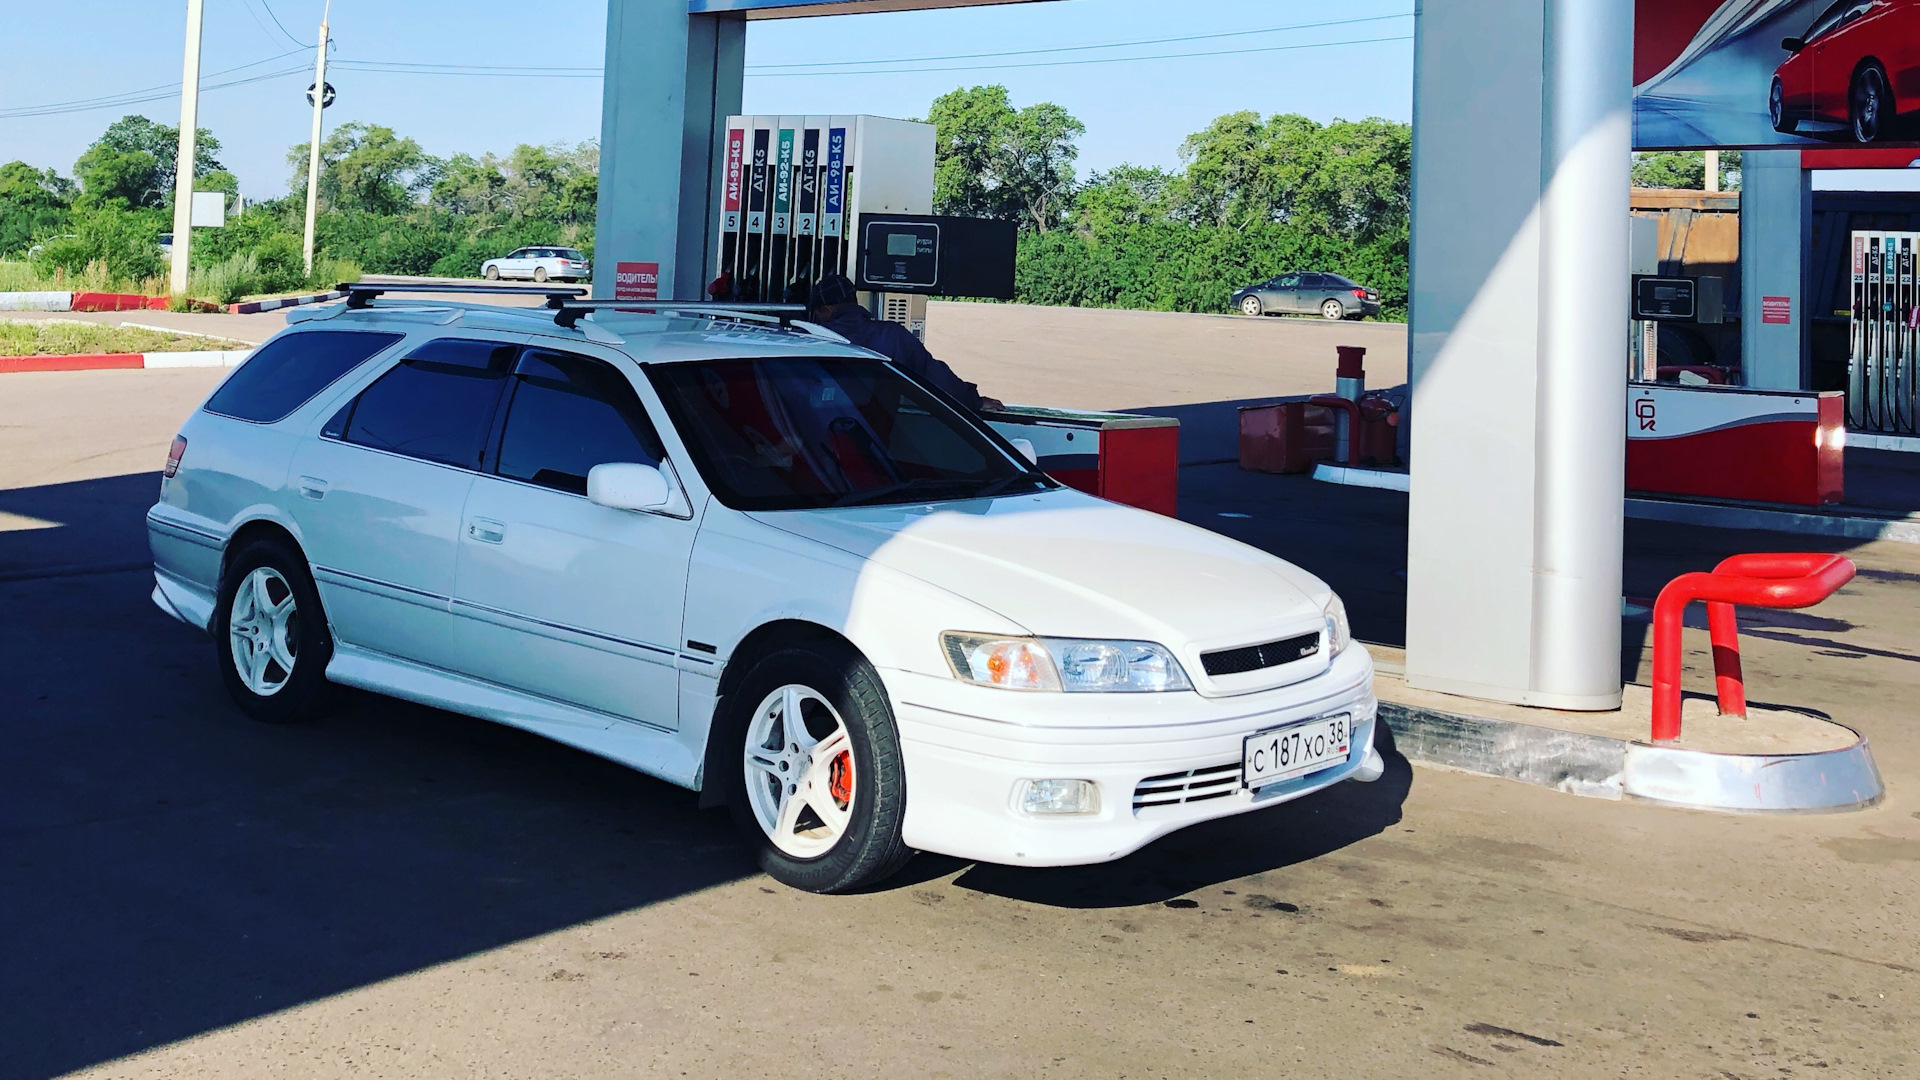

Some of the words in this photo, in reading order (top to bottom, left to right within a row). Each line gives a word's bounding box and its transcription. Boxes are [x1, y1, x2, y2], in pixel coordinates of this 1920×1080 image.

[778, 140, 791, 202] АИ-92-К5
[829, 135, 842, 206] АИ-98-К5
[728, 216, 735, 227] 5
[752, 216, 760, 228] 4
[777, 217, 785, 229] 3
[803, 218, 811, 230] 2
[830, 219, 836, 231] 1
[1270, 732, 1300, 769] 187
[1329, 721, 1344, 745] 38
